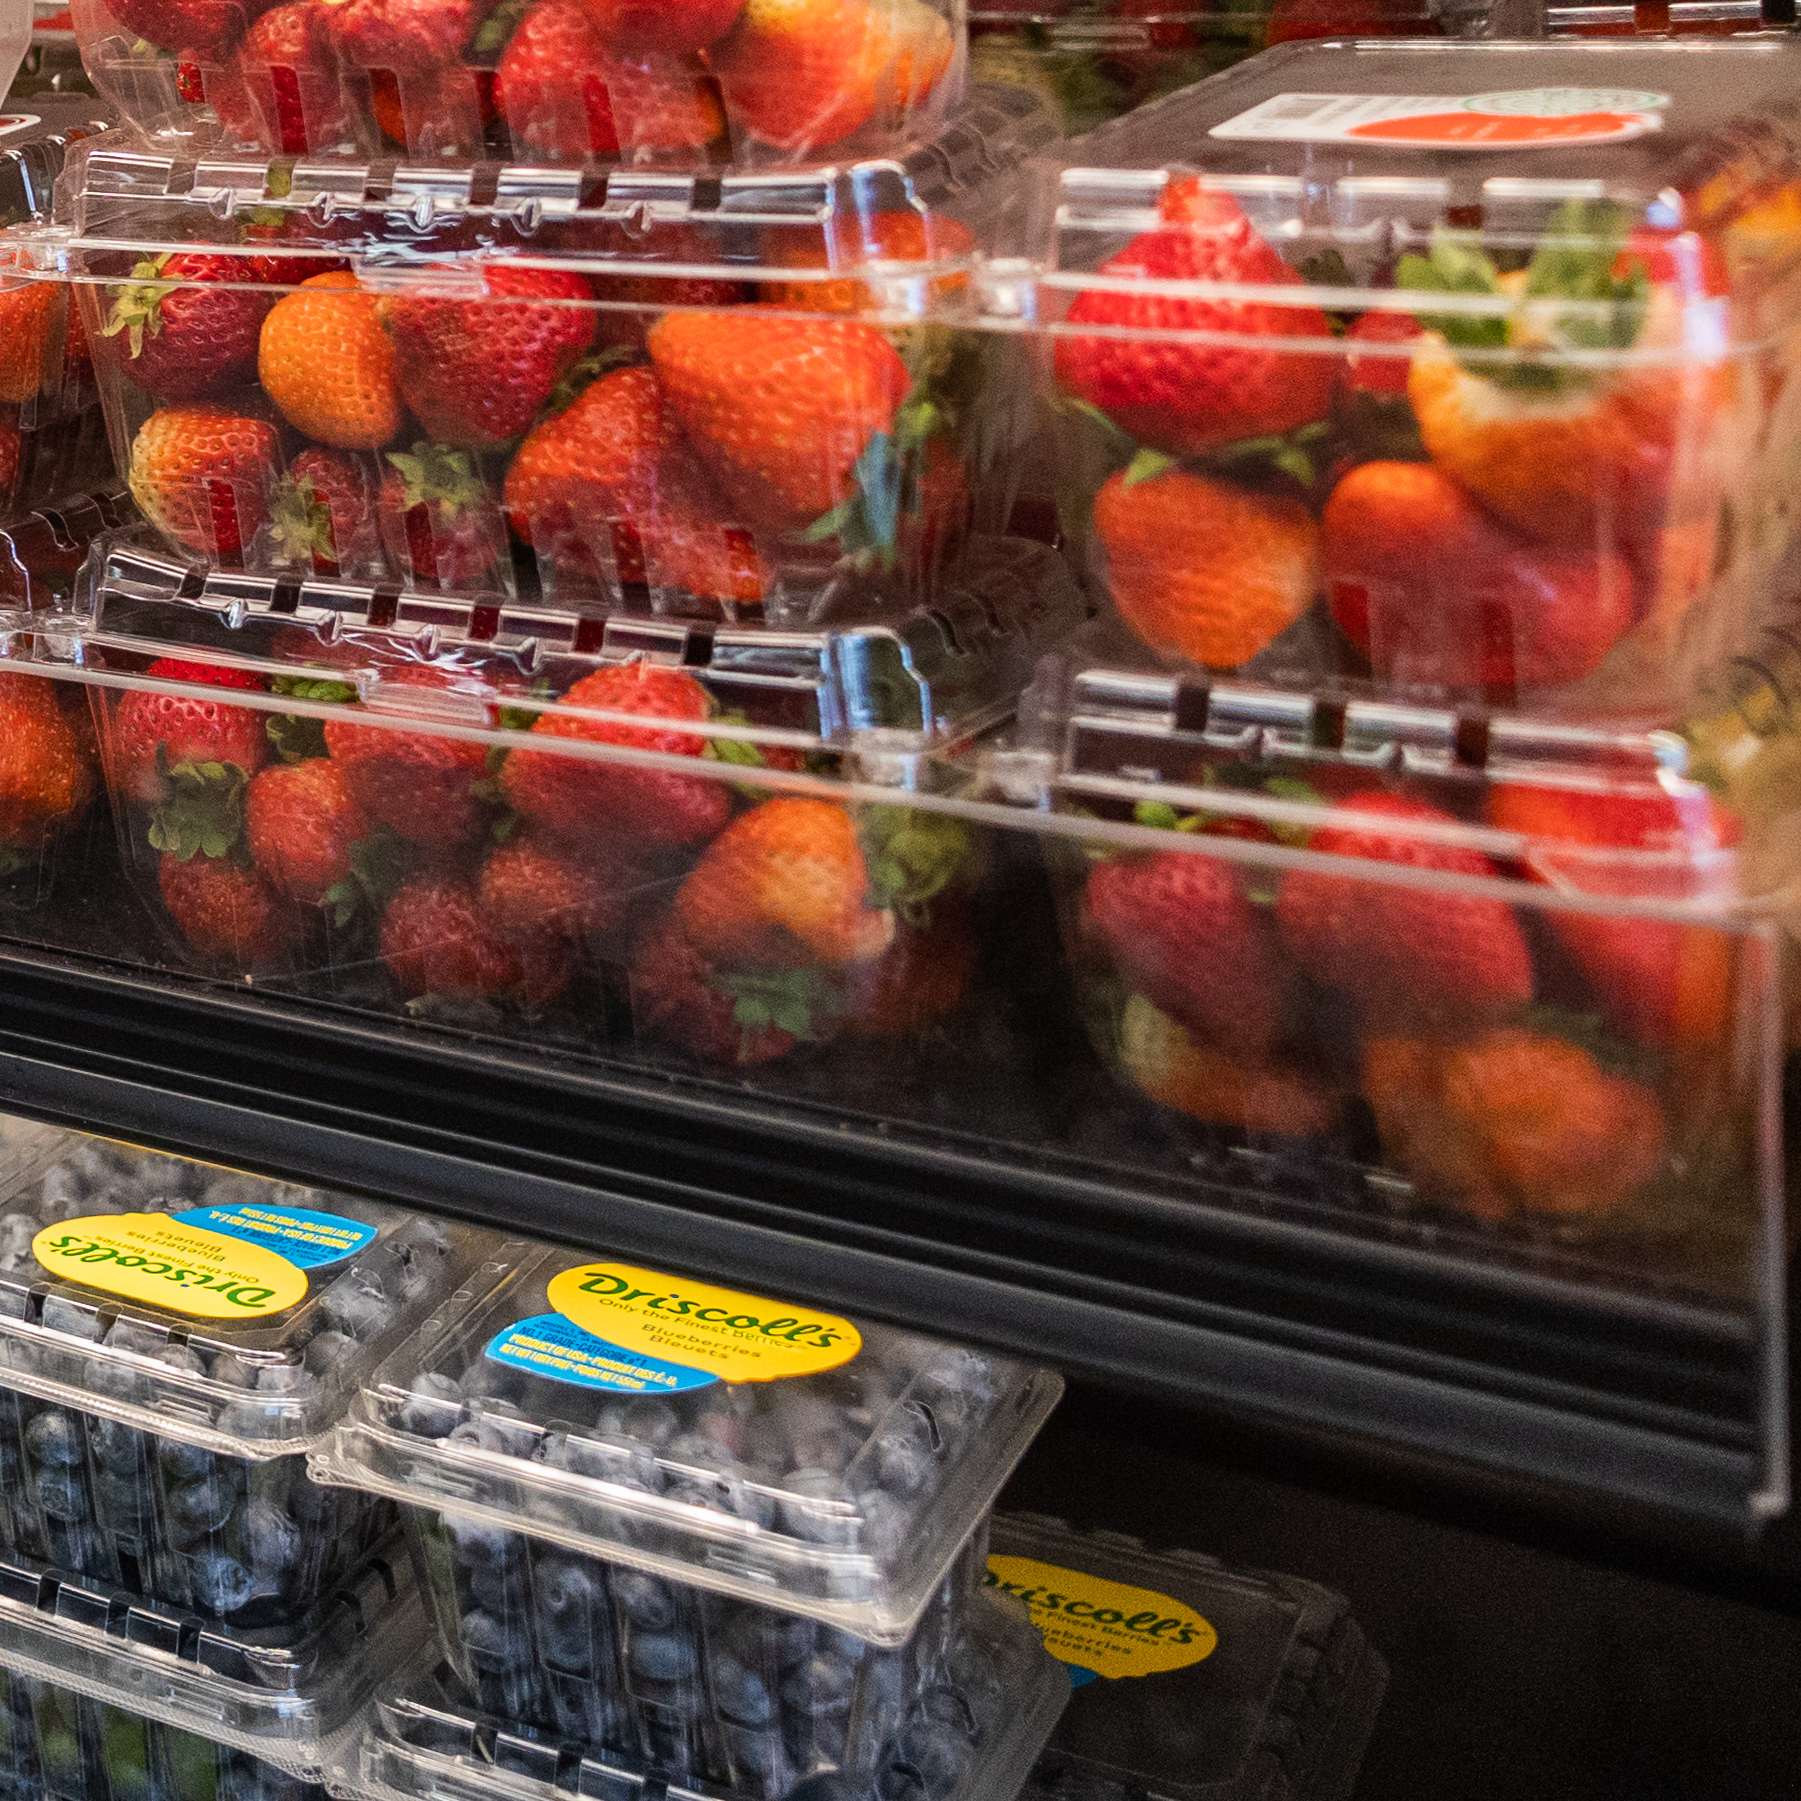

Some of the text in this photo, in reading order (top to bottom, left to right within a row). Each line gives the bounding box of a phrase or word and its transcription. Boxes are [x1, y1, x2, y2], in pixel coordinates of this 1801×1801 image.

[125, 1229, 227, 1263] Blueberries
[154, 1229, 223, 1253] Bleuets
[49, 1235, 277, 1309] Driscoll's
[149, 1250, 195, 1269] Finest
[198, 1263, 221, 1278] the
[577, 1271, 843, 1350] Driscoll's
[597, 1298, 639, 1320] Only
[641, 1308, 671, 1322] the
[674, 1315, 722, 1335] Finest
[508, 1331, 553, 1353] PRODUCT
[553, 1344, 567, 1357] OF
[567, 1348, 589, 1363] USA
[641, 1322, 763, 1359] Blueberries
[649, 1335, 729, 1361] Bleuets
[1047, 1636, 1103, 1657] euets
